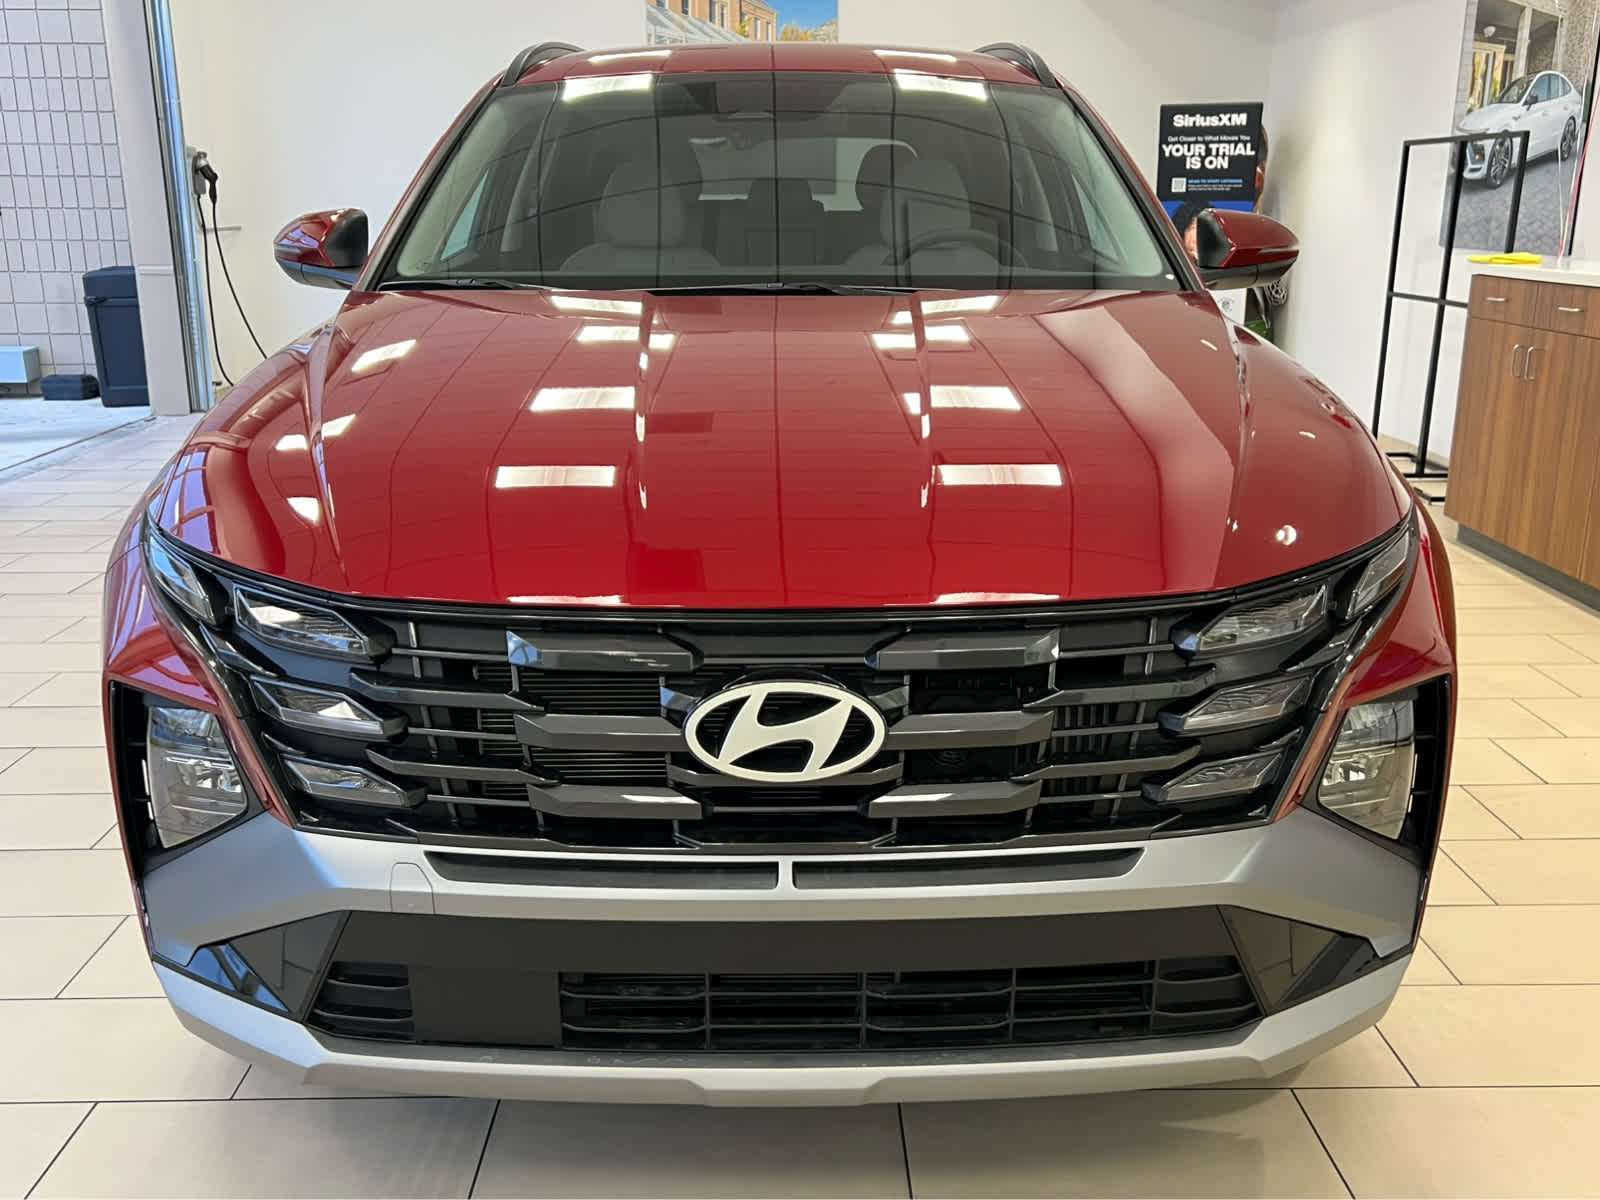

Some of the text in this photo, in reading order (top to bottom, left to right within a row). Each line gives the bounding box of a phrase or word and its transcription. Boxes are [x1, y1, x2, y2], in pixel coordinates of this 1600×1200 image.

[1173, 113, 1248, 127] SiriusXM
[1162, 143, 1256, 157] YOUR TRIAL
[1186, 156, 1229, 169] IS ON
